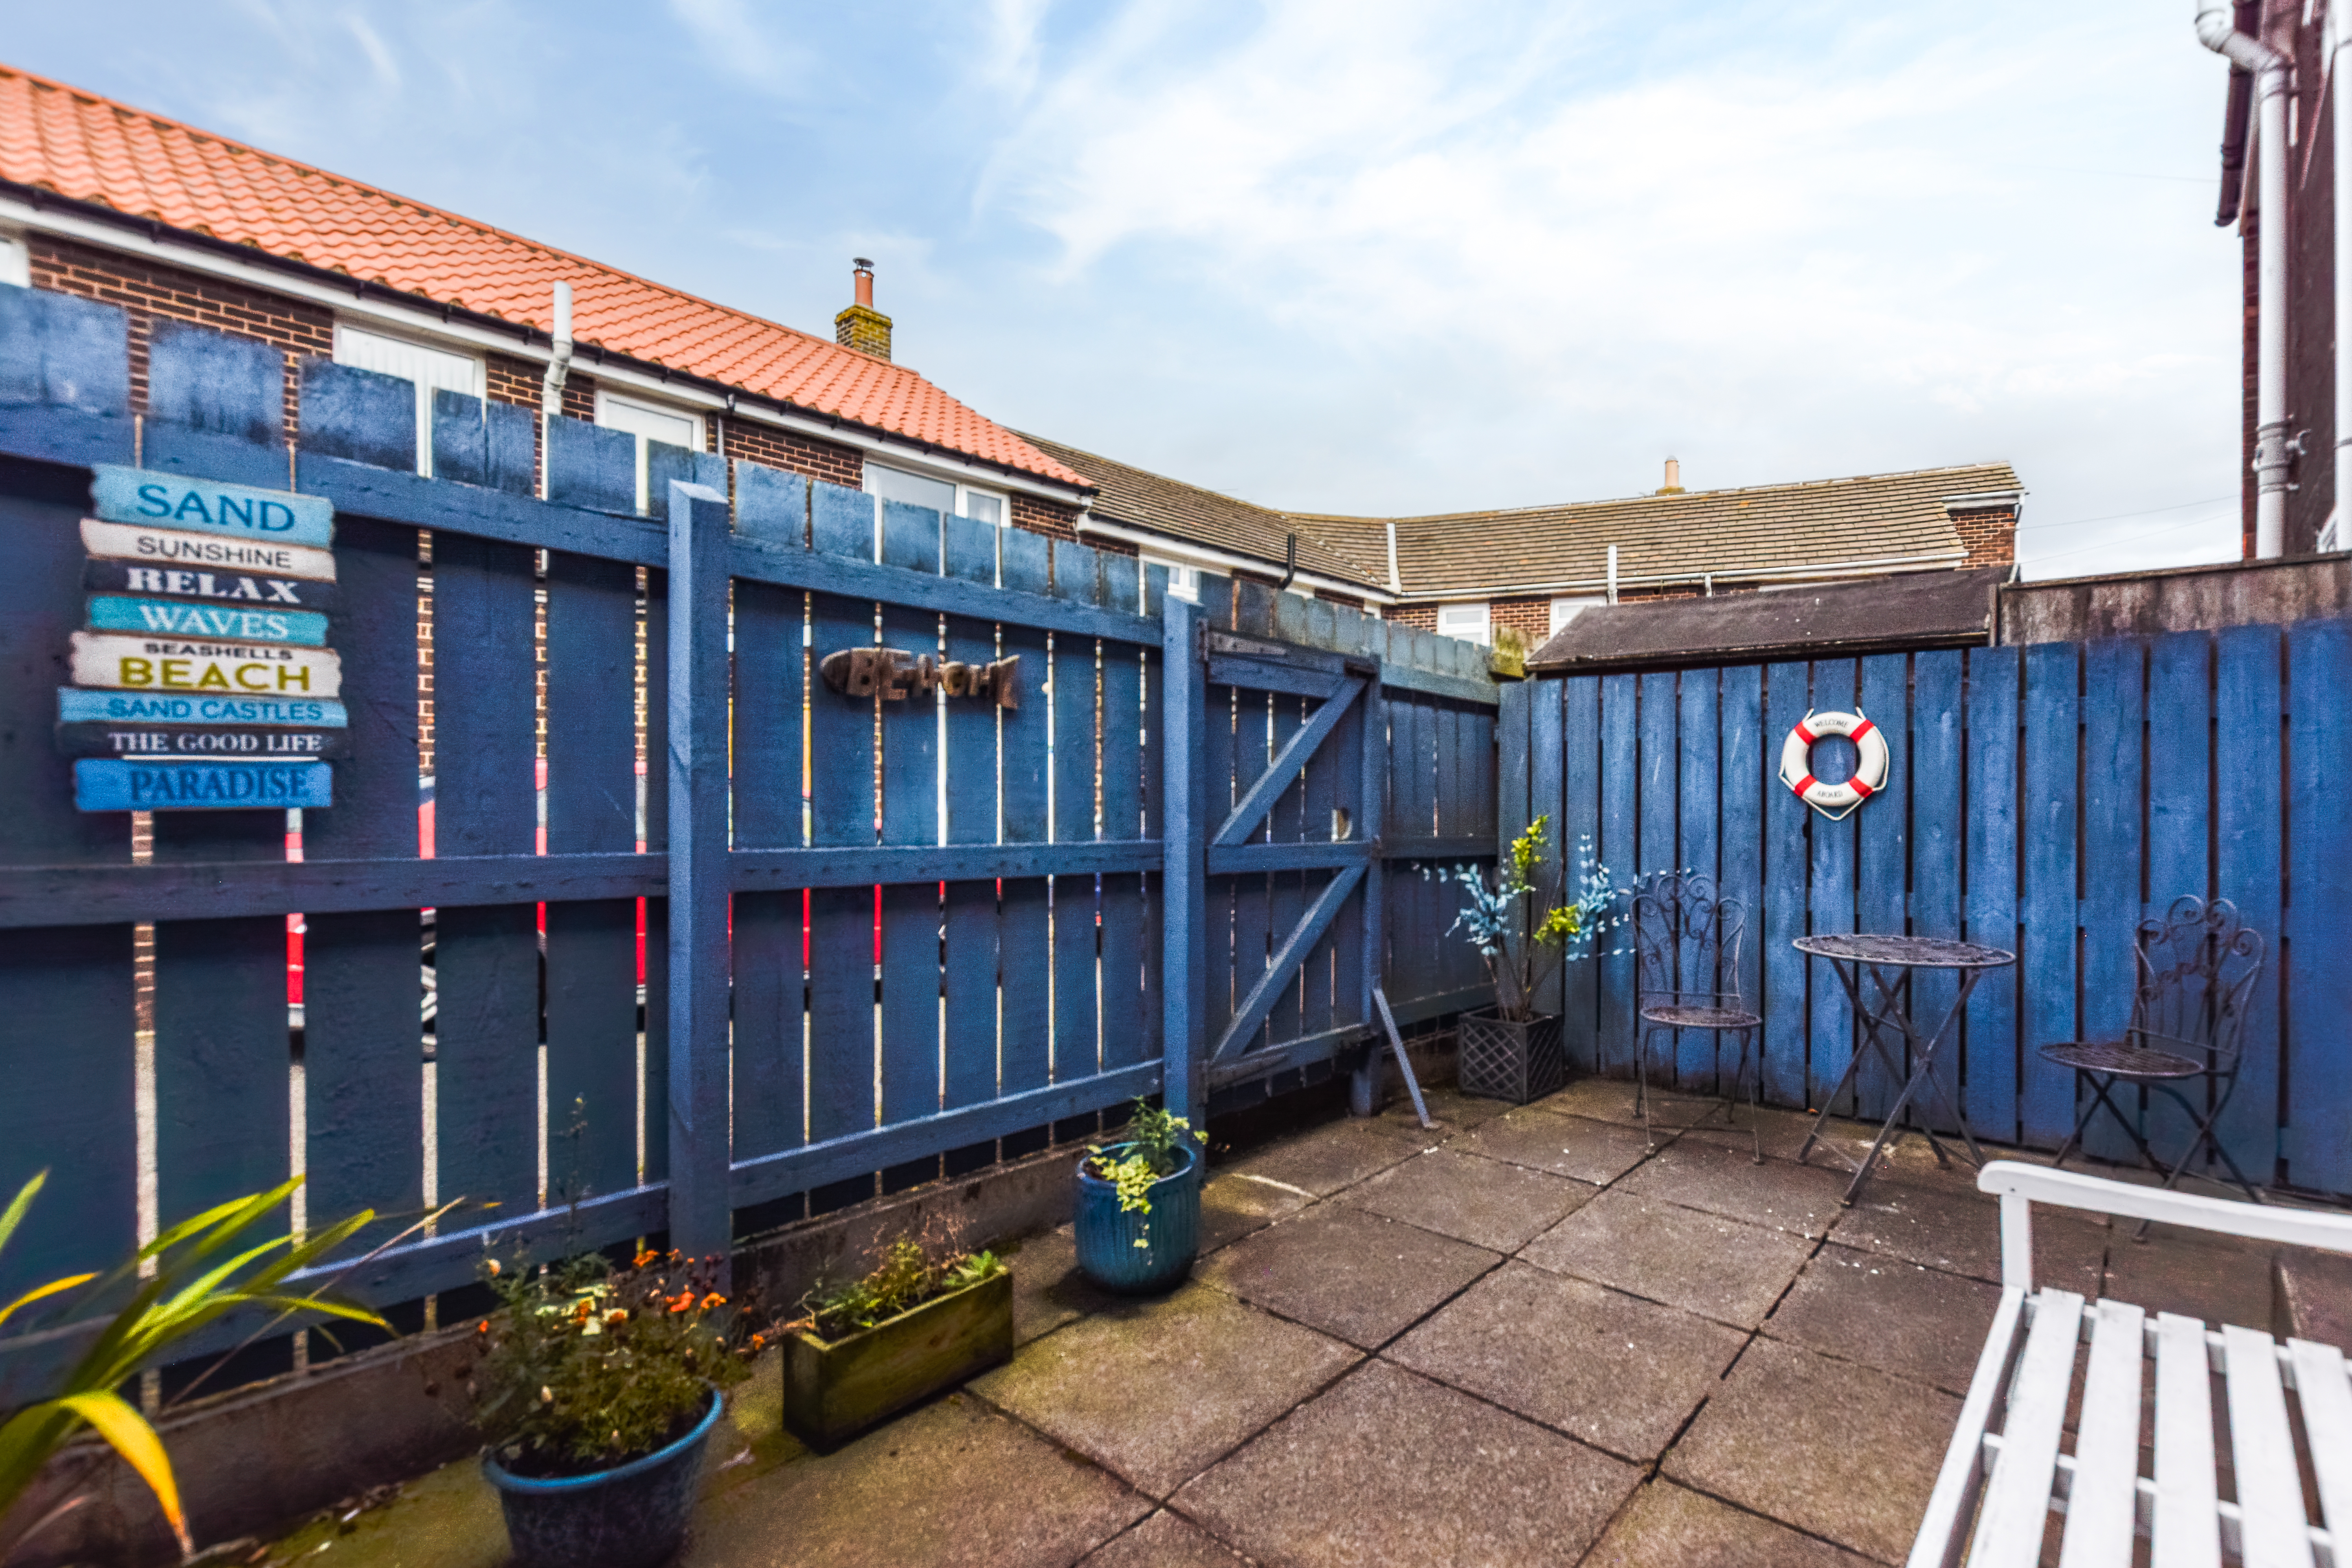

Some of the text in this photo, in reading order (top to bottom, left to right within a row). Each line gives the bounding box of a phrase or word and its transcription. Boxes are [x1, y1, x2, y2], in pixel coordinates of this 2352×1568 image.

[138, 484, 296, 532] SAND
[138, 535, 291, 569] SUNSHINE
[127, 567, 301, 604] RELAX
[138, 605, 289, 640] WAVES
[144, 642, 293, 661] SEASHELLS
[119, 656, 310, 692] BEACH
[108, 698, 323, 722] SAND CASTLES
[1814, 719, 1849, 727] WELCOME
[107, 732, 323, 753] THE GOOD LIFE
[130, 767, 310, 801] PARADISE
